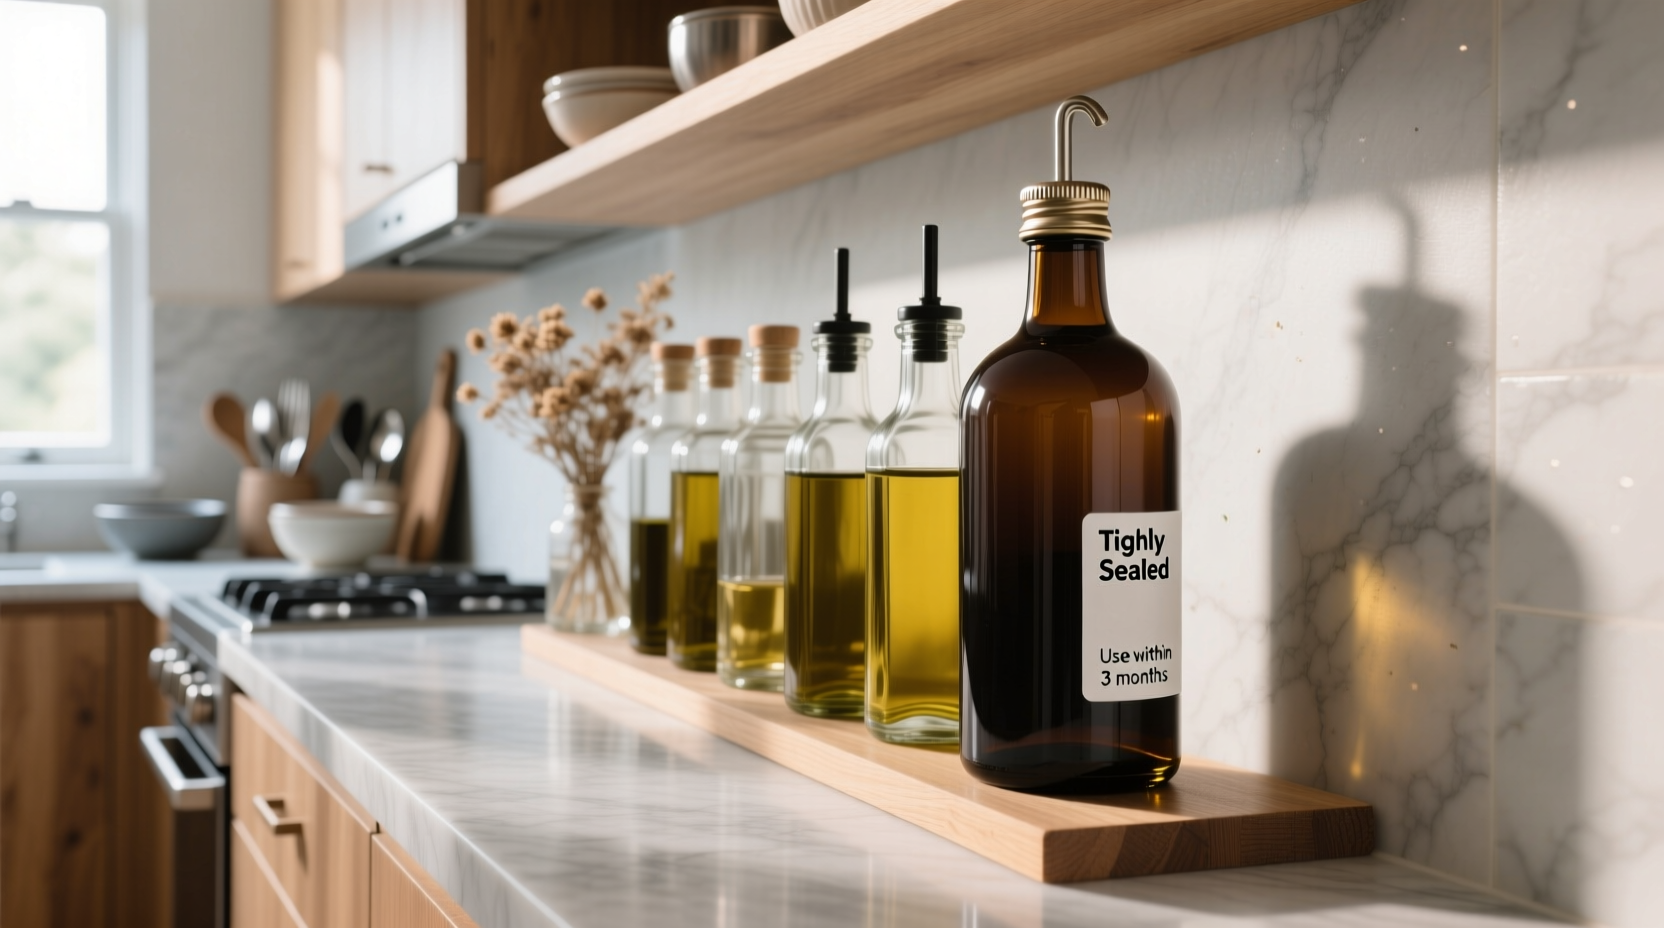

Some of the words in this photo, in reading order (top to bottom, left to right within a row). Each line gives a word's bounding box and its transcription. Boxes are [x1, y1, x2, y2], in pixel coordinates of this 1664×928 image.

[1098, 527, 1166, 557] Tighly
[1098, 556, 1170, 582] Sealed
[1100, 647, 1131, 664] Use
[1133, 644, 1172, 663] within
[1100, 670, 1112, 687] 3
[1116, 666, 1169, 686] months
